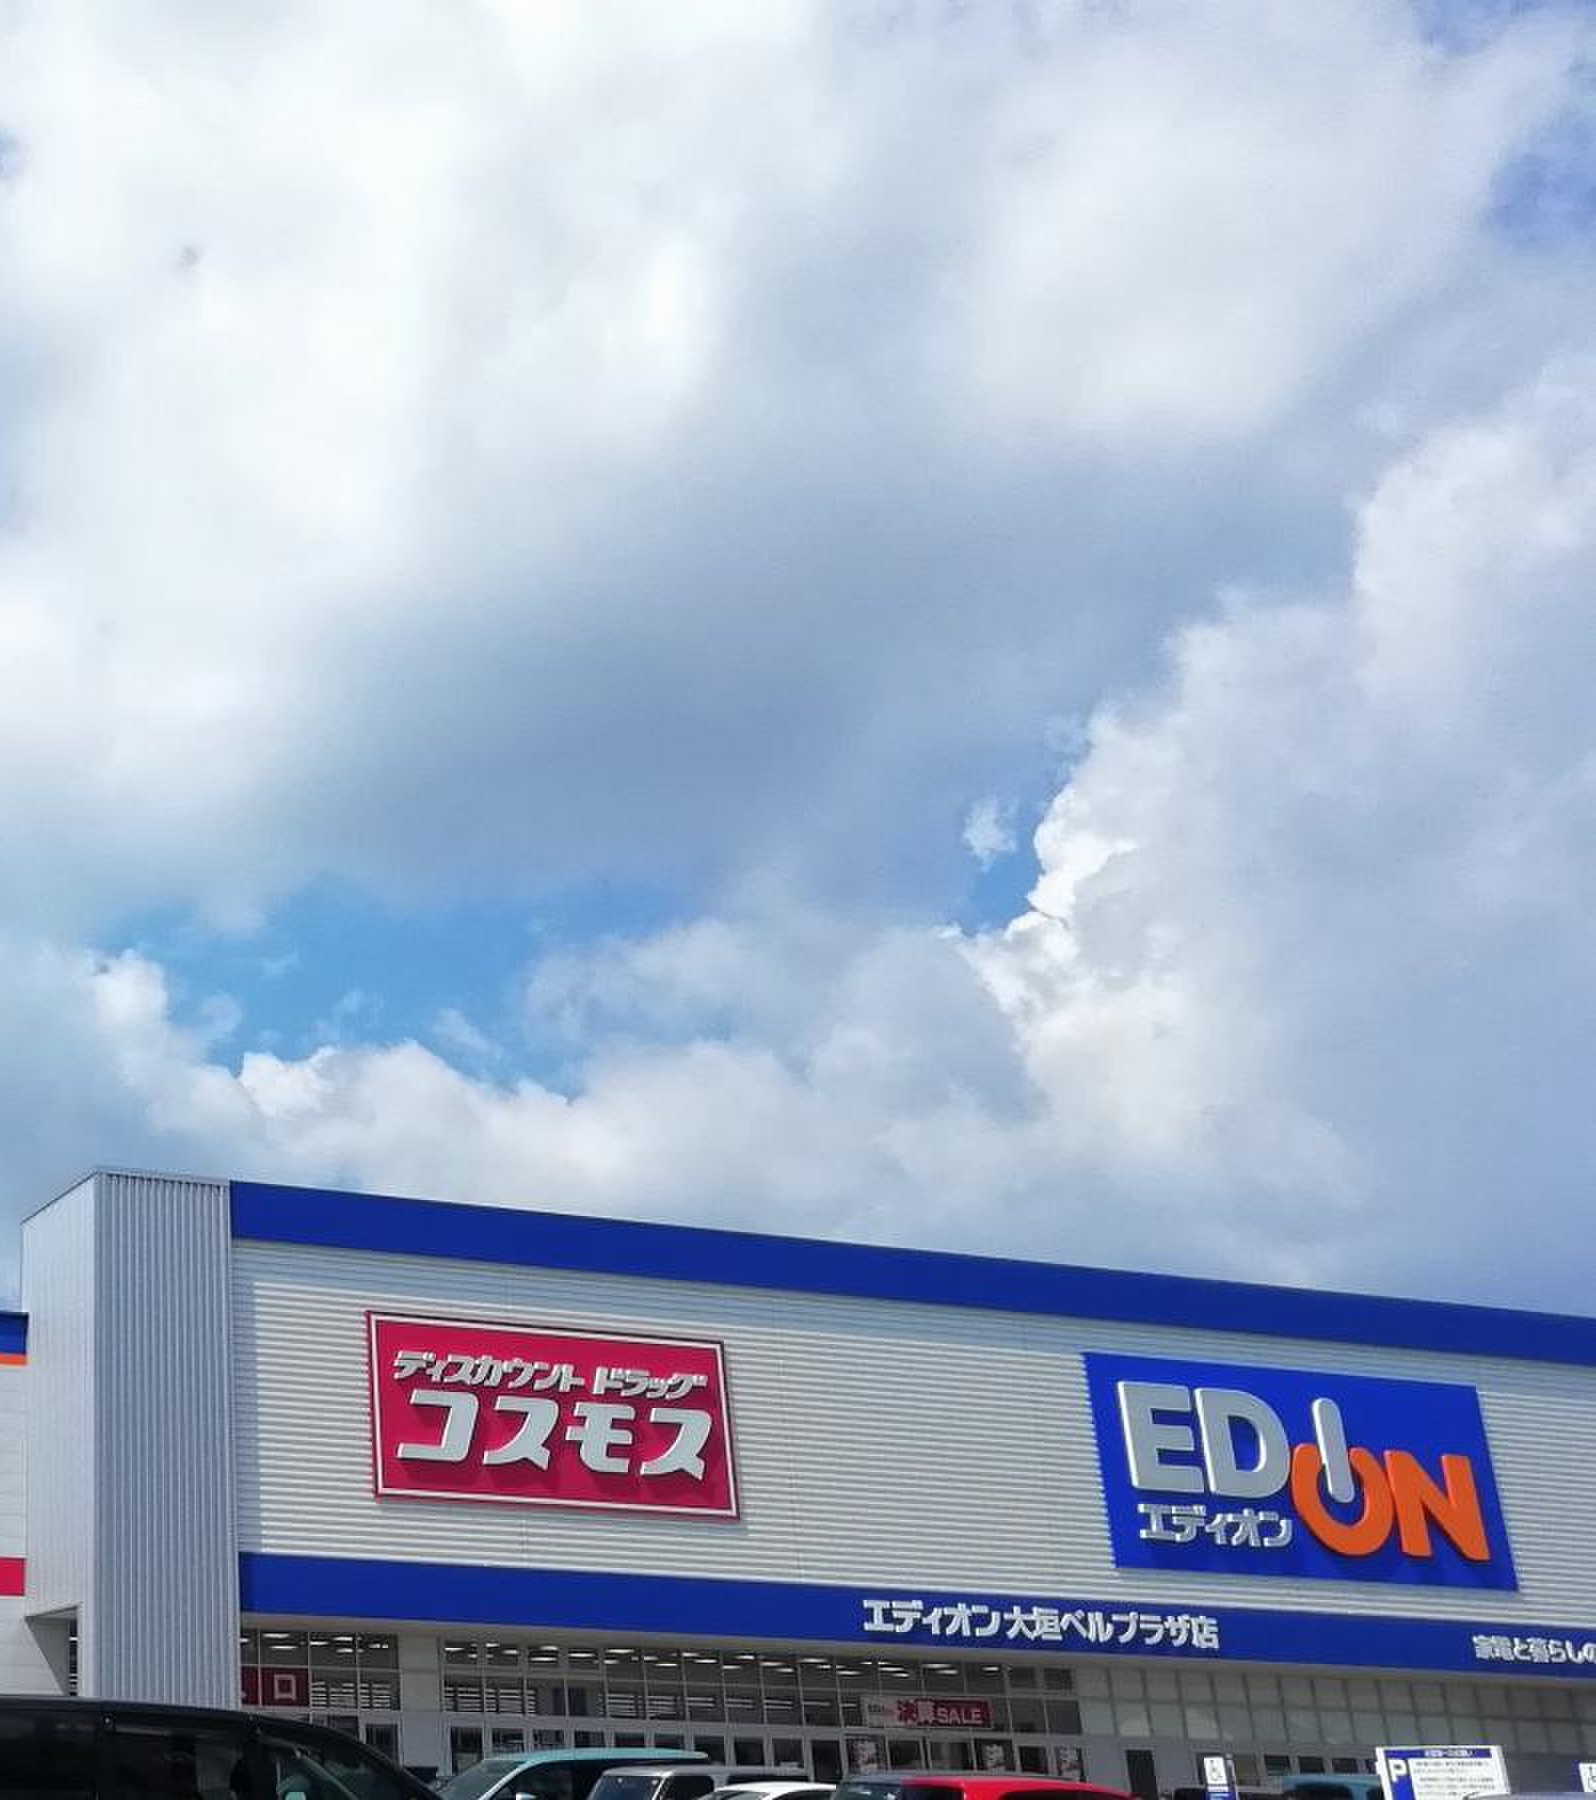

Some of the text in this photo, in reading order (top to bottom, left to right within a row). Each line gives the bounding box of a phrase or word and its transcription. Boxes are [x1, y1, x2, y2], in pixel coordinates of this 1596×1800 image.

[393, 1350, 708, 1399] ディスカウント ドラッグ
[397, 1390, 713, 1480] コスモス
[1117, 1380, 1492, 1561] EDION
[1138, 1502, 1294, 1548] エディオン
[862, 1600, 1220, 1649] エディオン大垣ベルプラザ店
